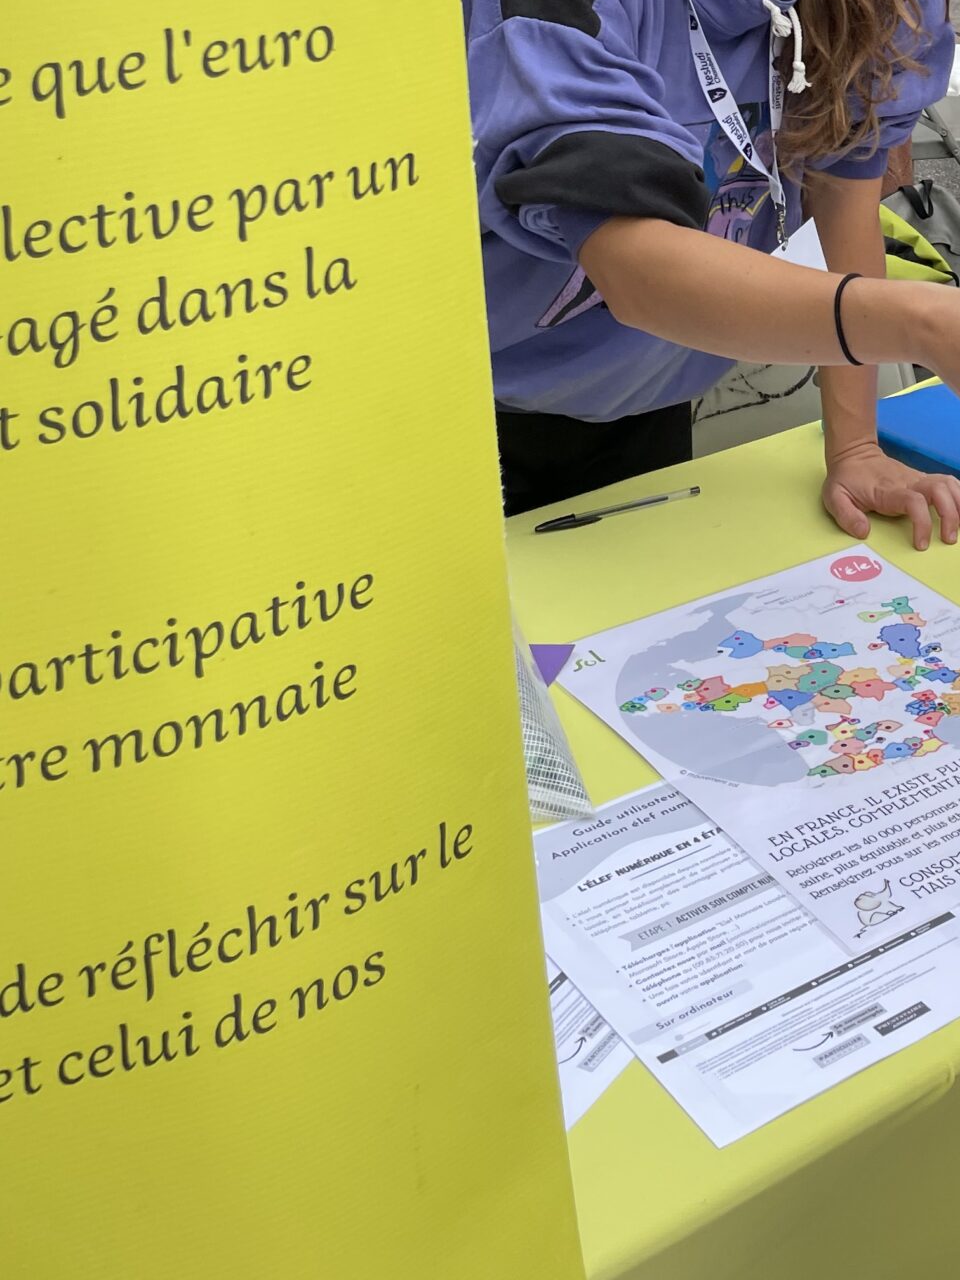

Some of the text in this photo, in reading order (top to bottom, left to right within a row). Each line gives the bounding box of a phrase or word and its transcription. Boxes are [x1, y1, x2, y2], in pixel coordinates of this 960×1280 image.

[31, 22, 335, 119] que l'euro
[228, 172, 335, 242] par
[347, 152, 419, 201] un
[0, 246, 358, 369] agé dans la
[38, 353, 313, 445] solidaire
[83, 660, 358, 773] monnaie
[552, 812, 656, 860] Application élef
[572, 791, 681, 837] Guide utilisateur
[768, 831, 794, 847] EN
[864, 794, 883, 807] IL
[882, 773, 937, 800] EXISTE
[786, 851, 845, 878] Rejoignez
[846, 841, 862, 854] les
[862, 835, 878, 846] 40
[878, 824, 904, 839] 000
[905, 801, 959, 829] personnes
[577, 874, 613, 892] L'ÉLEF
[615, 848, 675, 876] NUMÉRIQUE
[675, 840, 692, 851] EN
[809, 869, 875, 900] Renseignez
[875, 859, 905, 873] vous
[905, 848, 923, 860] sur
[923, 838, 940, 851] les
[833, 859, 860, 876] plus
[859, 836, 911, 863] équitable
[912, 828, 925, 840] et
[925, 820, 948, 837] plus
[0, 821, 473, 1018] de réfléchir sur le
[675, 904, 711, 924] ACTIVER
[709, 896, 728, 909] SON
[726, 883, 760, 902] COMPTE
[911, 875, 957, 900] MAIS
[57, 1011, 200, 1086] celui
[214, 993, 278, 1048] de
[289, 950, 388, 1019] nos
[656, 990, 735, 1031] Sur ordinateur
